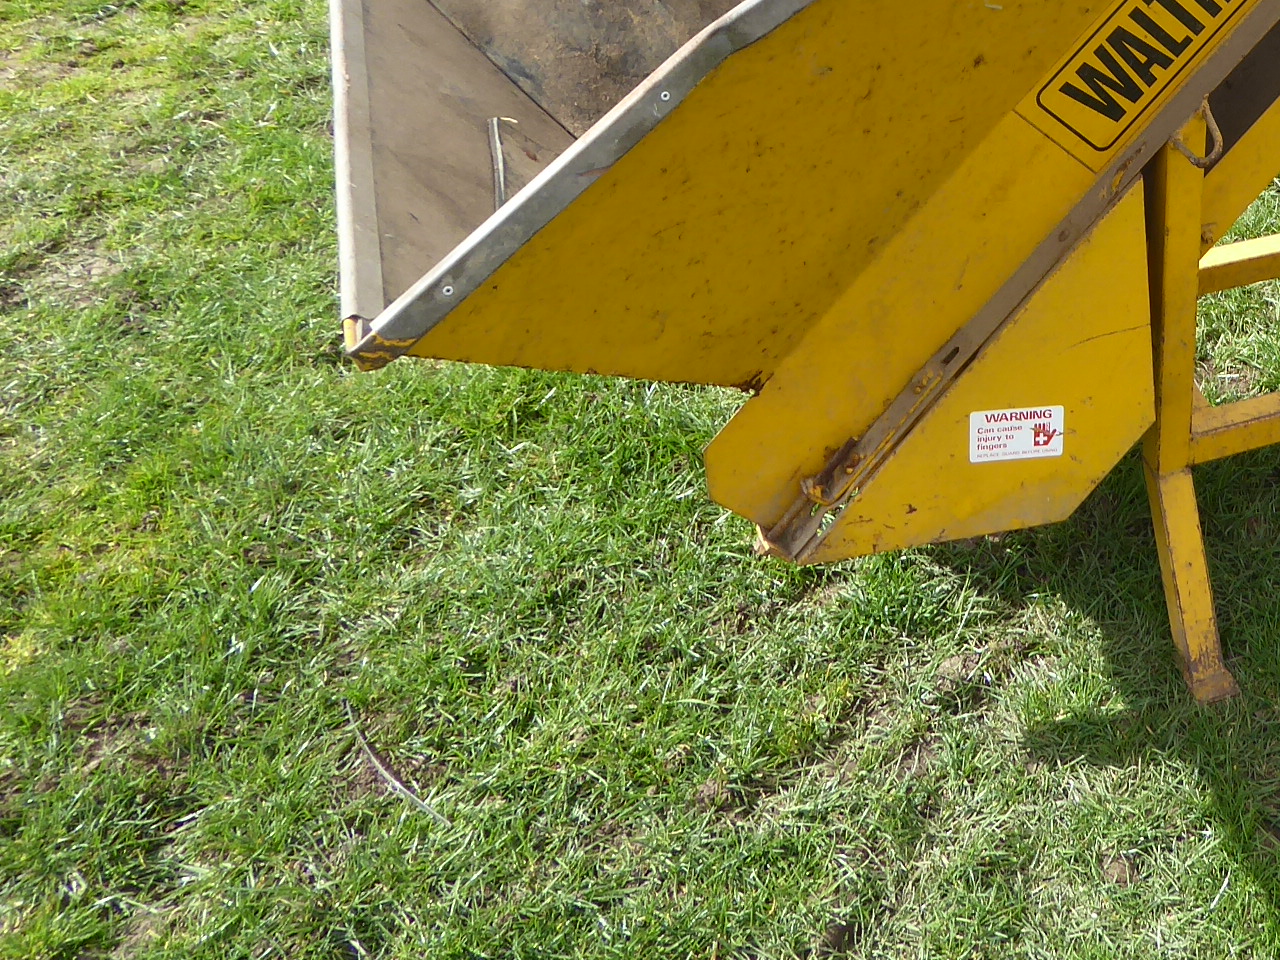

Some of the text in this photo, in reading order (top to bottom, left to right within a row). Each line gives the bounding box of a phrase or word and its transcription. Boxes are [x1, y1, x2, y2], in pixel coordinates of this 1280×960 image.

[984, 409, 1052, 423] WARNING
[997, 425, 1023, 433] cause
[977, 435, 1002, 443] injury
[977, 443, 1008, 451] fingers
